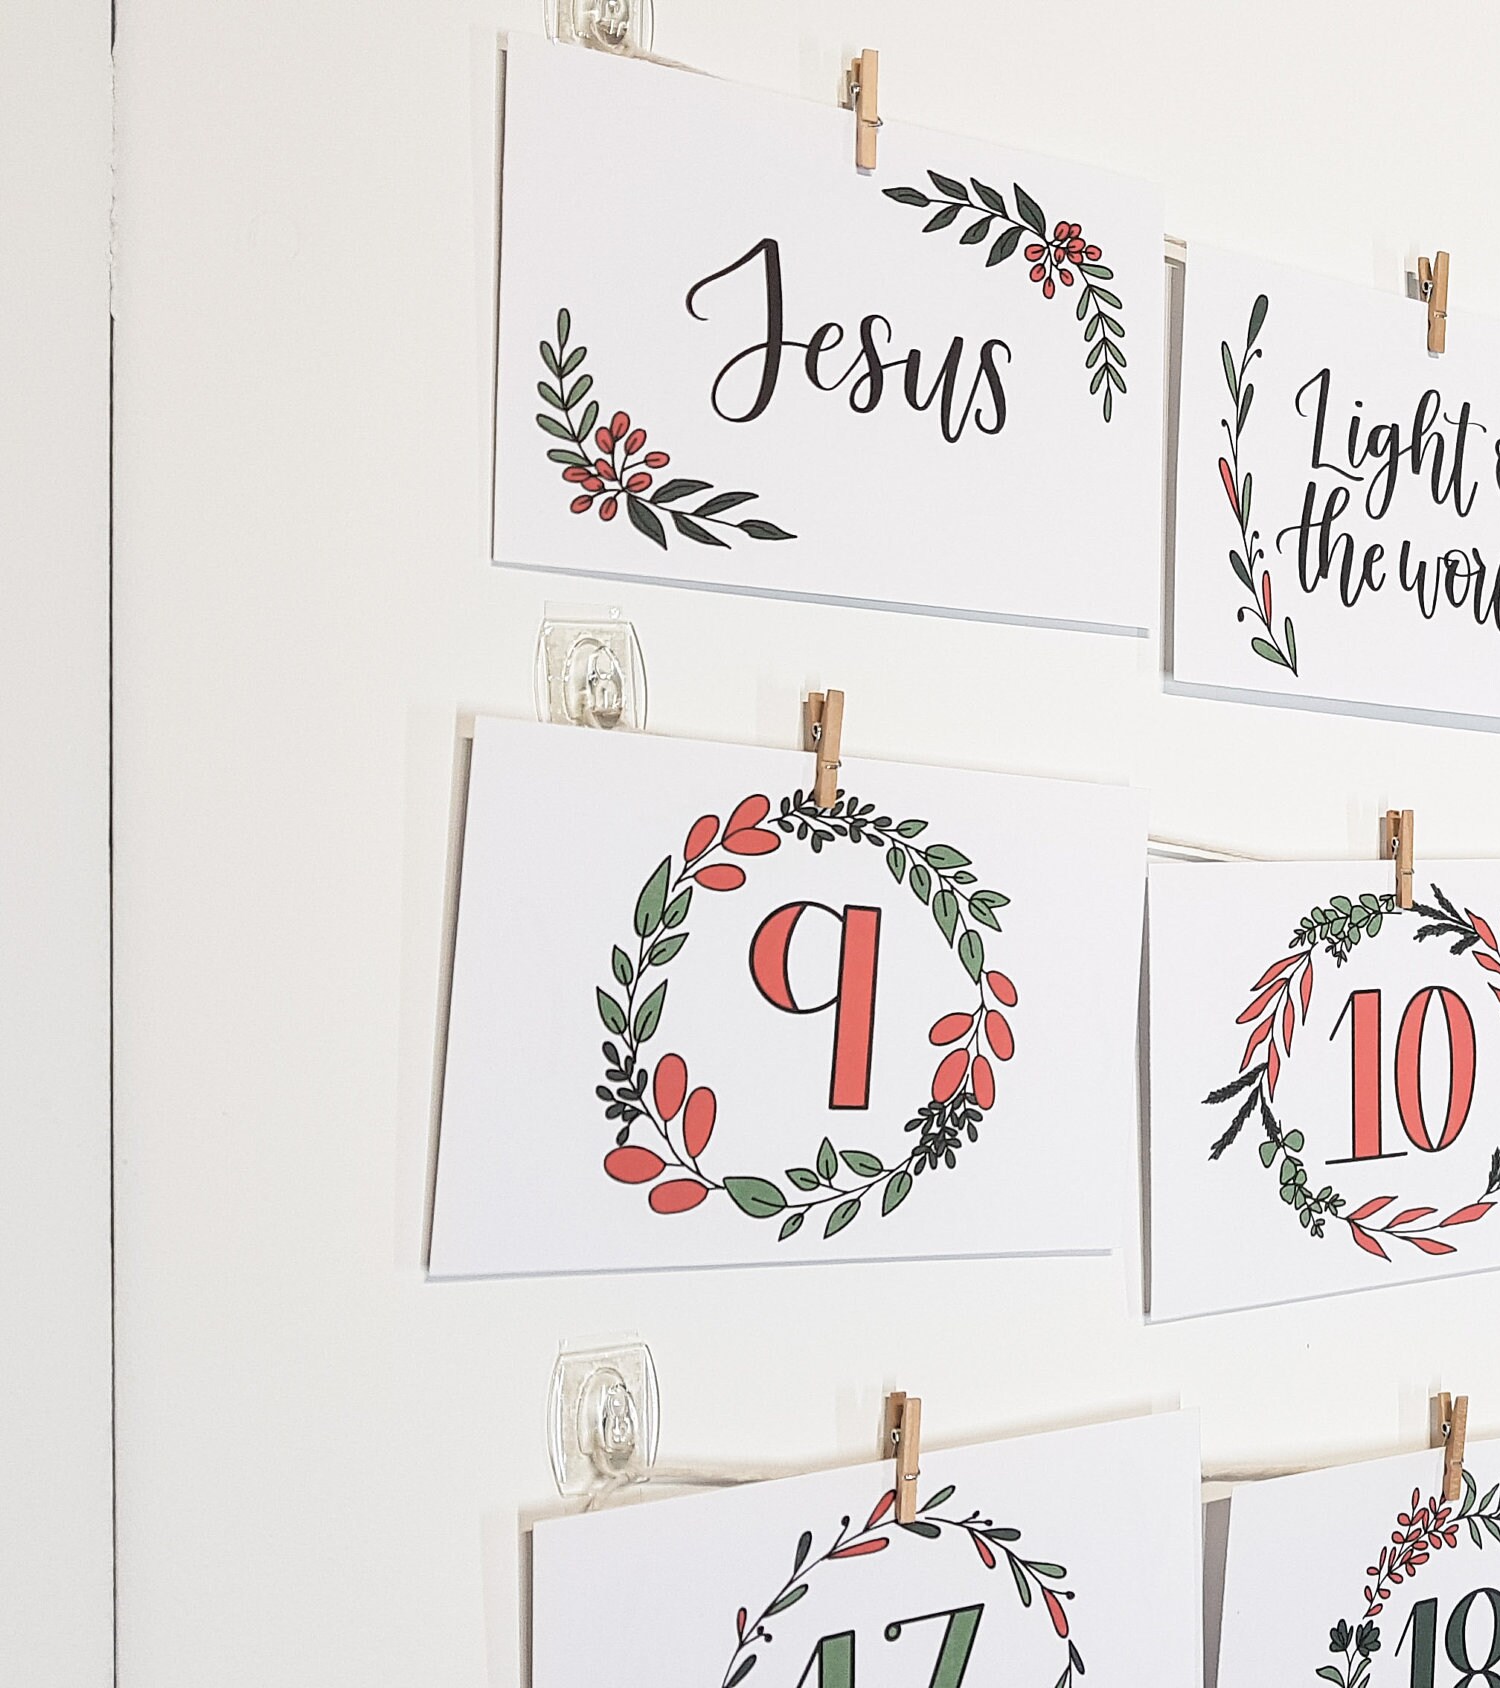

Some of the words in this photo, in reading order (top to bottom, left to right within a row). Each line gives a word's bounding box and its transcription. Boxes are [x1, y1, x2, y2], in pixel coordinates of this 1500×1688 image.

[686, 238, 1011, 443] Jesus
[1294, 367, 1487, 520] Light
[1275, 482, 1386, 605] the
[748, 900, 883, 1111] 9
[1325, 985, 1477, 1165] 10
